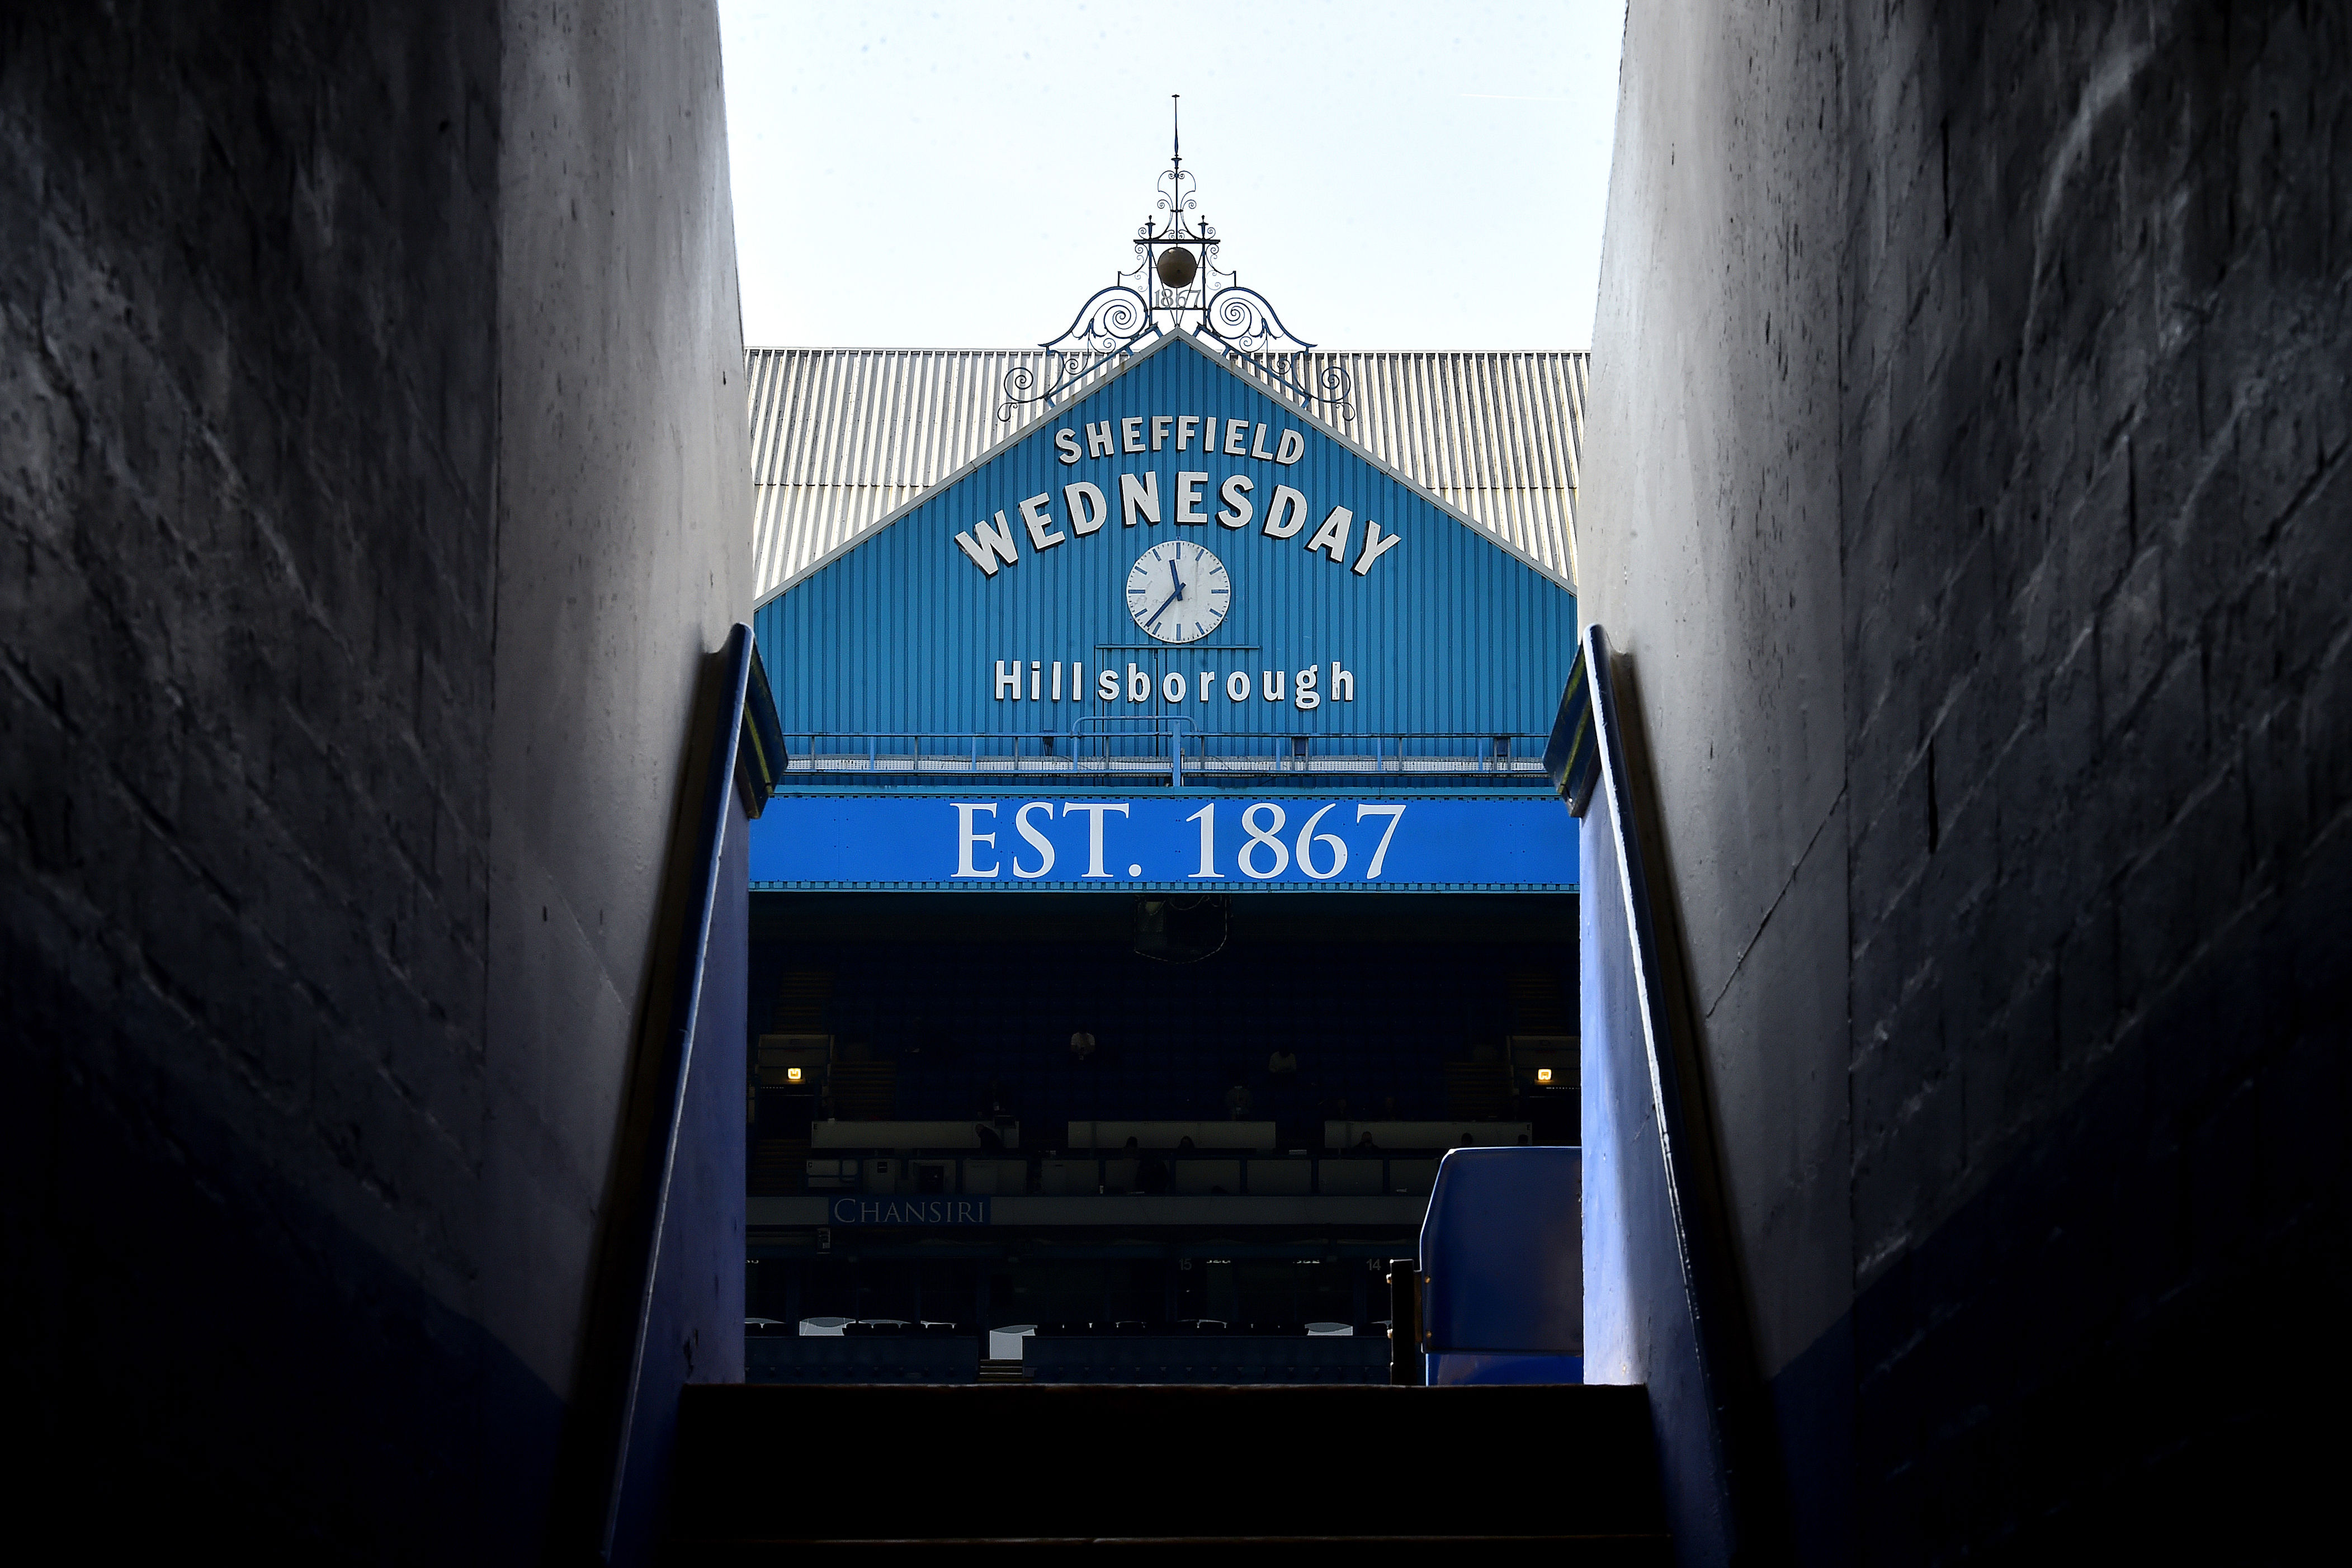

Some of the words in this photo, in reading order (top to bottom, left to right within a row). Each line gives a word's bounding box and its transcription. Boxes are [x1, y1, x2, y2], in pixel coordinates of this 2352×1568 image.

[1155, 289, 1201, 308] 1867
[1055, 415, 1305, 465] SHEFFIELD
[955, 471, 1402, 576] WEDNESDAY
[995, 660, 1354, 710] Hillsborough
[950, 802, 1142, 879] EST.
[1186, 802, 1407, 880] 1867
[834, 1198, 984, 1223] CHANSIRI
[1179, 1258, 1193, 1271] 15
[1366, 1258, 1382, 1271] 14
